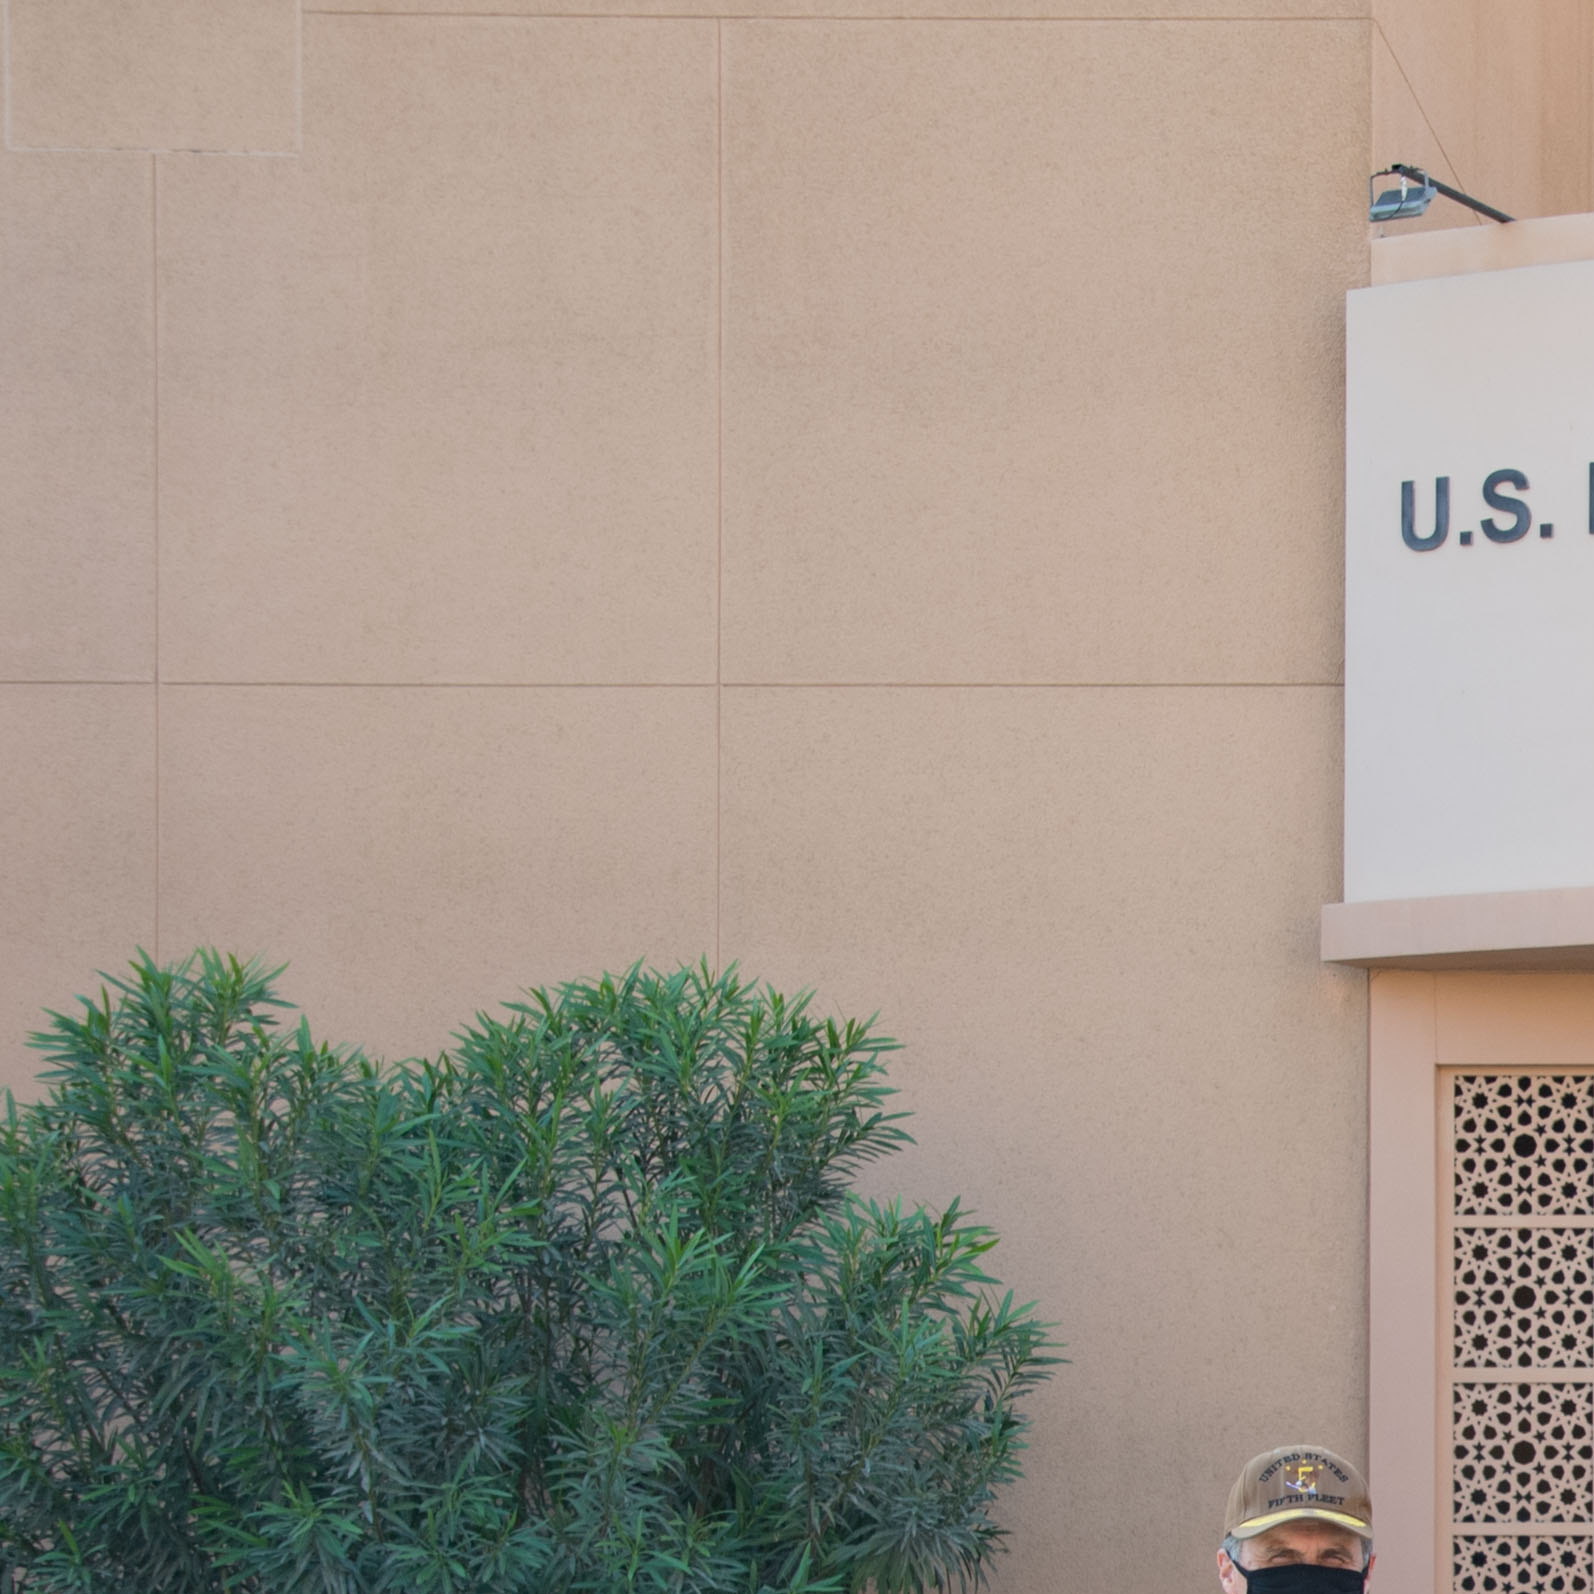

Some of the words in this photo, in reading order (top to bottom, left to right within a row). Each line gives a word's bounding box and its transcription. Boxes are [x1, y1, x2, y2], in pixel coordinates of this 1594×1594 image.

[1402, 469, 1553, 552] U.S.
[1259, 1453, 1300, 1483] UNITED
[1305, 1453, 1349, 1483] STATES
[1268, 1494, 1303, 1509] FIFTH
[1308, 1494, 1344, 1506] FLEET
